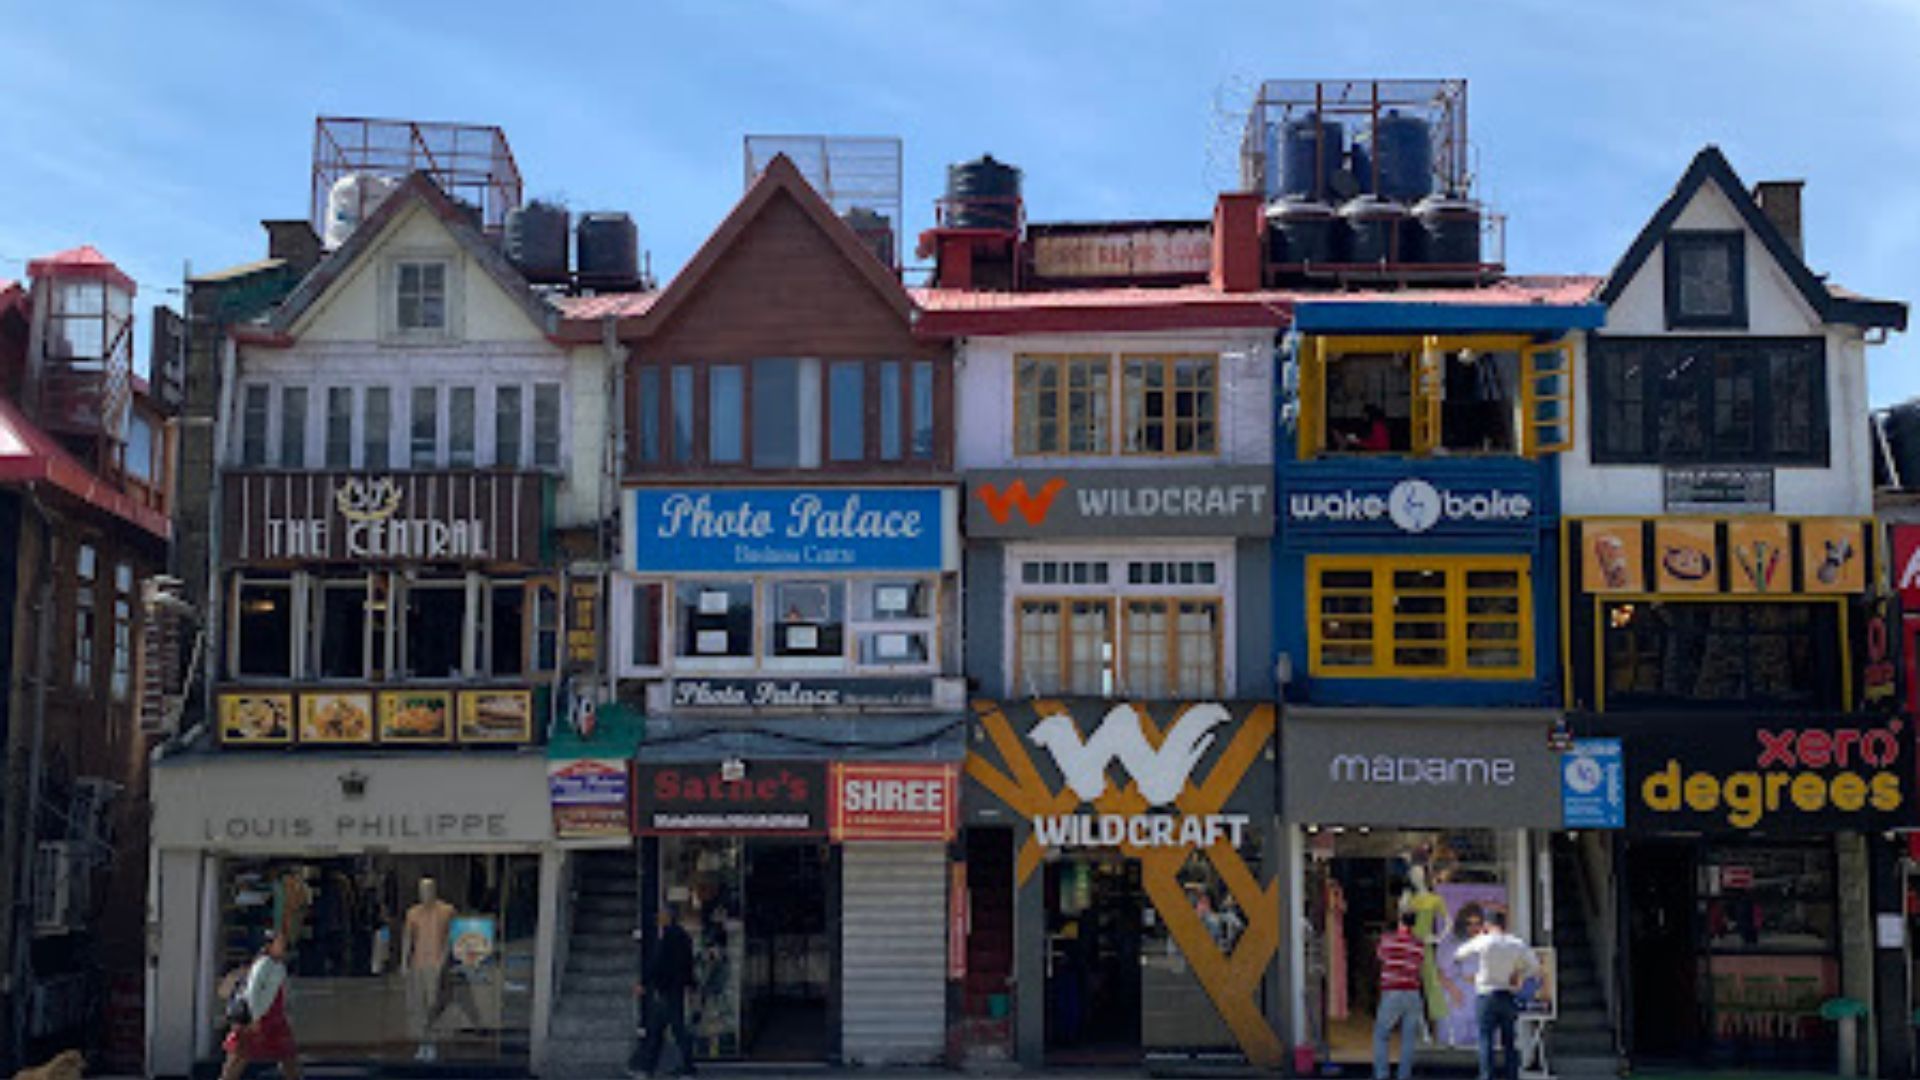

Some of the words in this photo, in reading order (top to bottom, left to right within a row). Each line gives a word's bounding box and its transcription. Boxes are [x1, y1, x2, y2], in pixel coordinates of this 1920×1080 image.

[657, 492, 774, 539] Photo
[785, 492, 925, 539] Palace
[1076, 484, 1267, 516] WILDCRAFT
[1289, 489, 1386, 520] wake
[1444, 488, 1532, 520] bake
[268, 518, 328, 556] THE
[349, 518, 488, 556] CENTRAL
[674, 681, 746, 705] Photo
[752, 681, 840, 705] Palace
[844, 778, 944, 812] SHREE
[1641, 757, 1903, 829] degrees
[203, 815, 314, 841] LOUIS
[336, 812, 508, 838] PHILIPPE
[1033, 813, 1250, 848] WILDCRAFT
